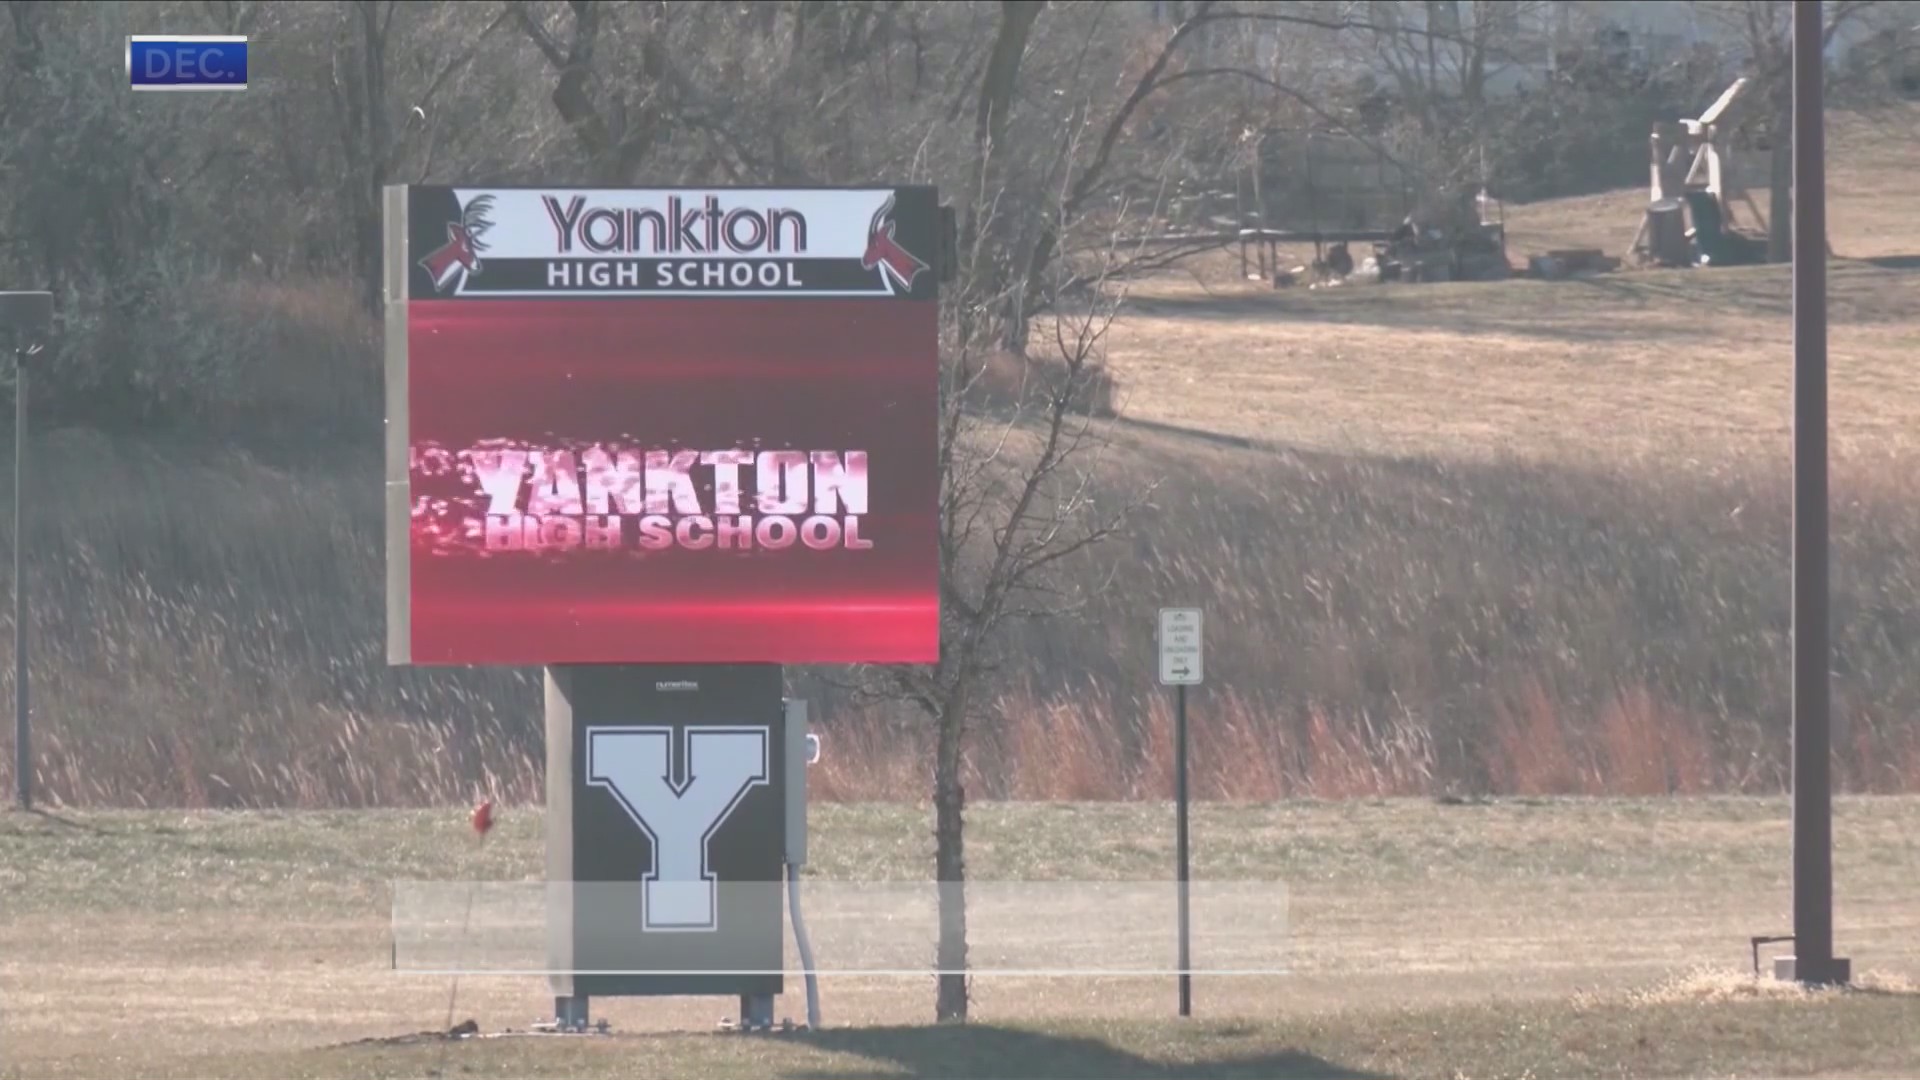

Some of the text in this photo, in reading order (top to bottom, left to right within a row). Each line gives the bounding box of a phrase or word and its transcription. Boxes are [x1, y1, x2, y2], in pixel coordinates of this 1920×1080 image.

[541, 194, 808, 255] Yankton
[547, 262, 803, 287] HIGH SCHOOL
[470, 450, 869, 515] YANKTON
[485, 515, 874, 550] HIGH SCHOOL
[586, 725, 770, 932] Y
